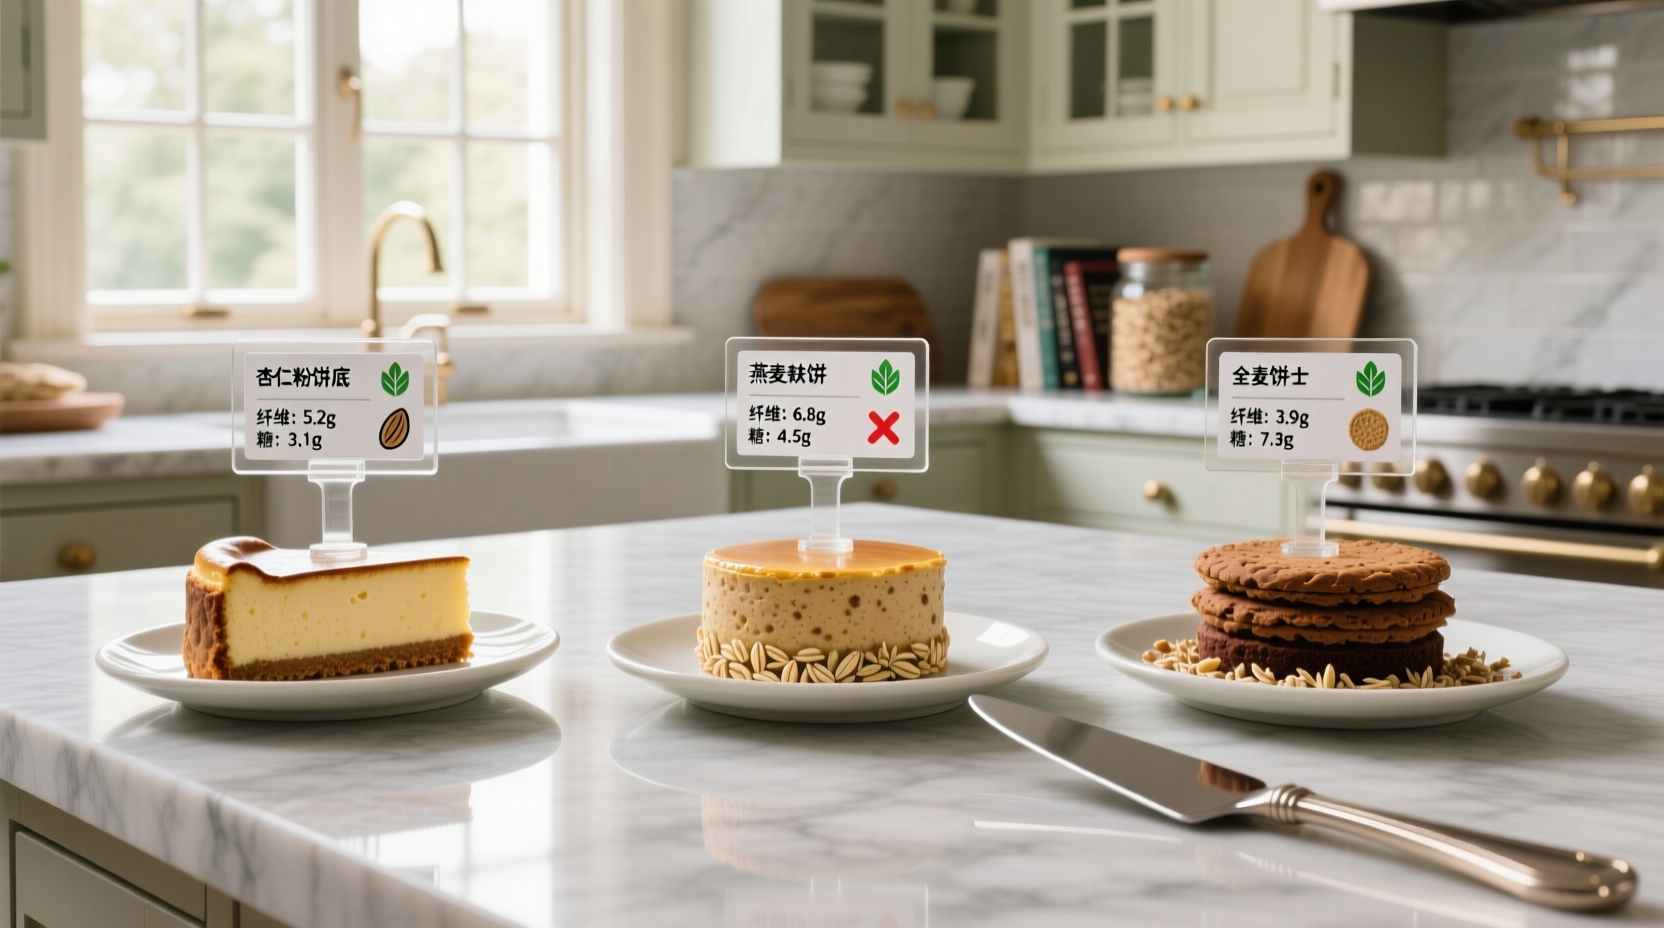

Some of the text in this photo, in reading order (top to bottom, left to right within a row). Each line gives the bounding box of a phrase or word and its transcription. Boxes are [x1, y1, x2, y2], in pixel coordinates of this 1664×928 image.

[255, 366, 351, 388] 杏仁粉饼底
[1232, 365, 1310, 387] 全麦饼士
[303, 409, 336, 429] 5.2g
[792, 407, 826, 426] 6.8g
[1275, 409, 1310, 429] 3.9g
[288, 432, 323, 450] 3.1g
[777, 429, 811, 447] 4.5g
[1260, 432, 1294, 450] 7.3g
